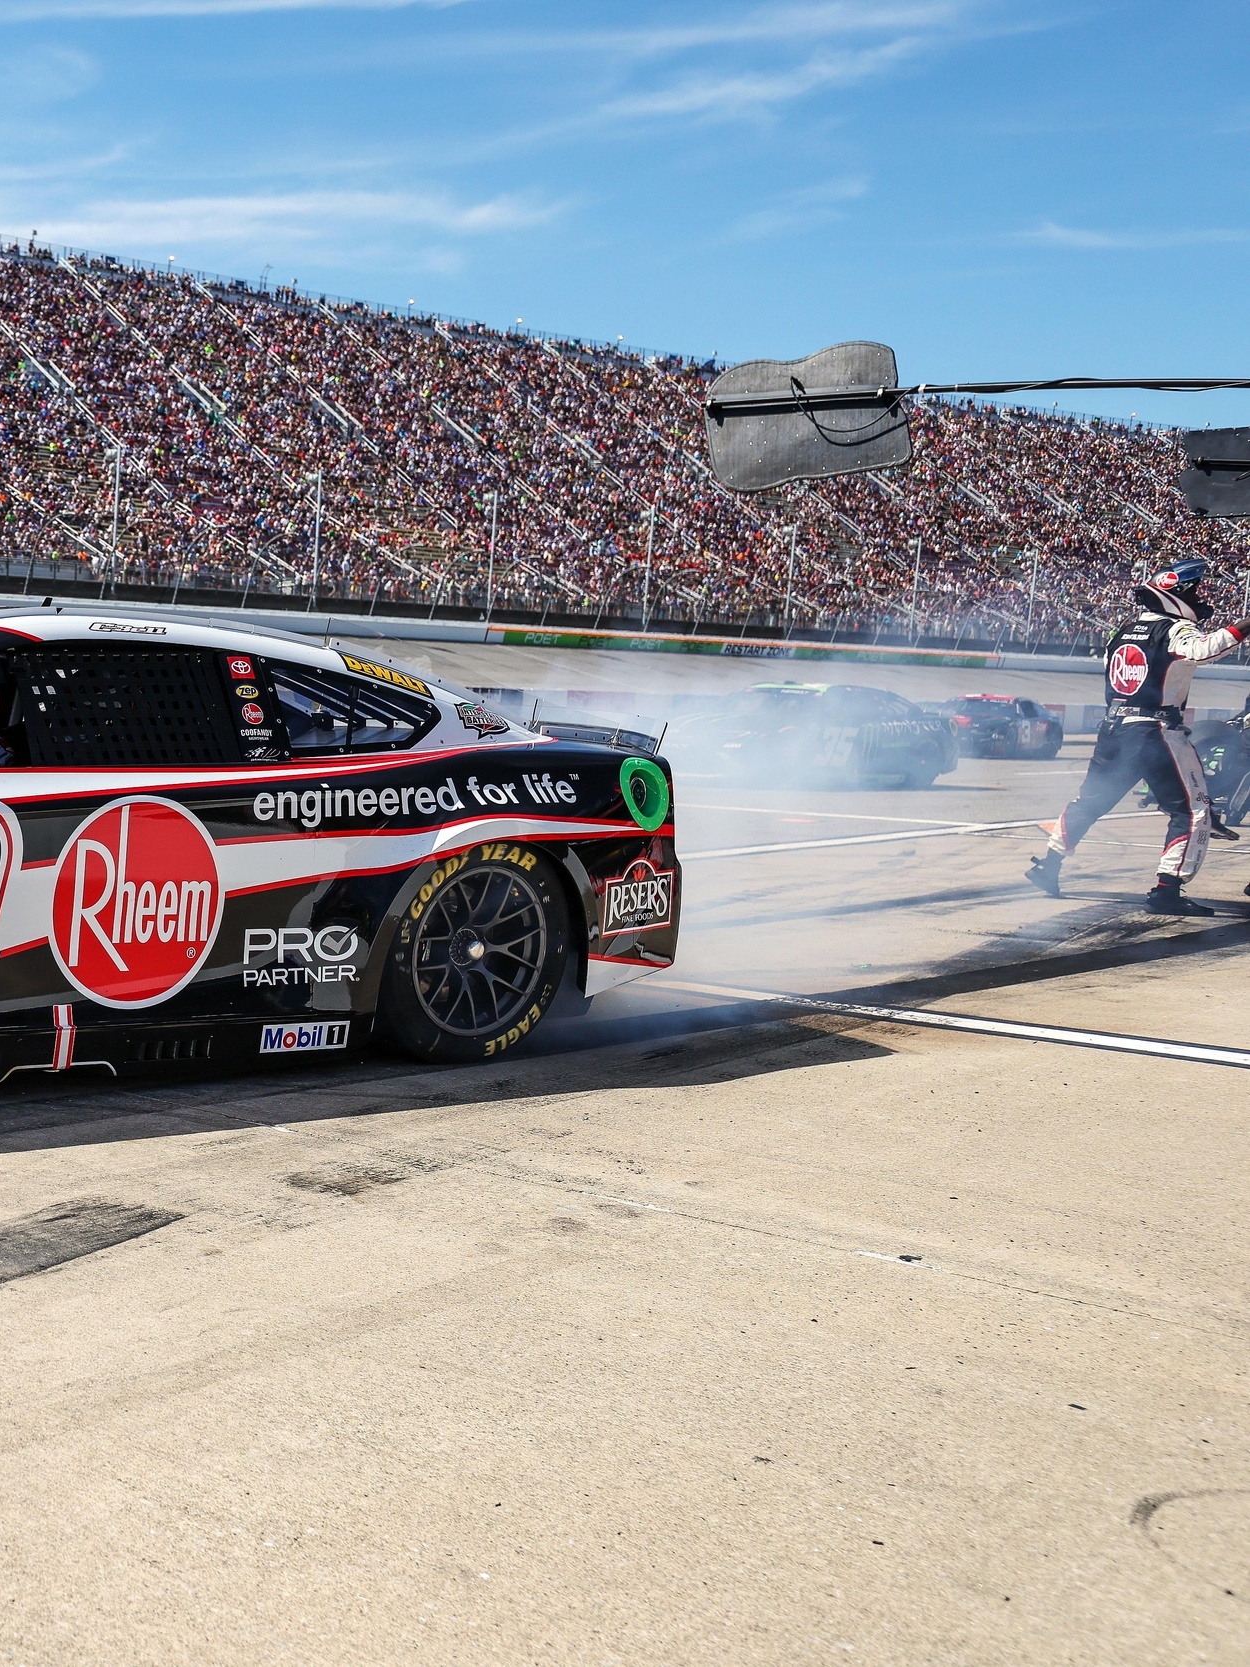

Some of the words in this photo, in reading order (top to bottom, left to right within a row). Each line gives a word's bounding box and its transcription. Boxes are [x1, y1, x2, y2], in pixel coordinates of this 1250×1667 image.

[524, 632, 562, 645] POET
[577, 636, 614, 648] POET
[630, 638, 665, 650] POET
[723, 643, 765, 656] RESTART
[766, 646, 792, 658] ZONE
[1112, 646, 1145, 687] Rheem
[461, 706, 502, 722] INTERSTATE
[466, 715, 506, 726] BATTERIES
[822, 726, 860, 768] 35
[252, 778, 465, 828] engineered
[467, 776, 519, 807] for
[68, 805, 212, 972] Rheem
[607, 876, 668, 929] RESER'S
[621, 914, 634, 924] FINE
[634, 912, 654, 922] FOODS
[243, 925, 359, 965] PRO
[243, 964, 358, 987] PARTNER
[263, 1025, 324, 1050] Mobil
[332, 1026, 340, 1044] 1
[483, 1003, 542, 1057] EAGLE
